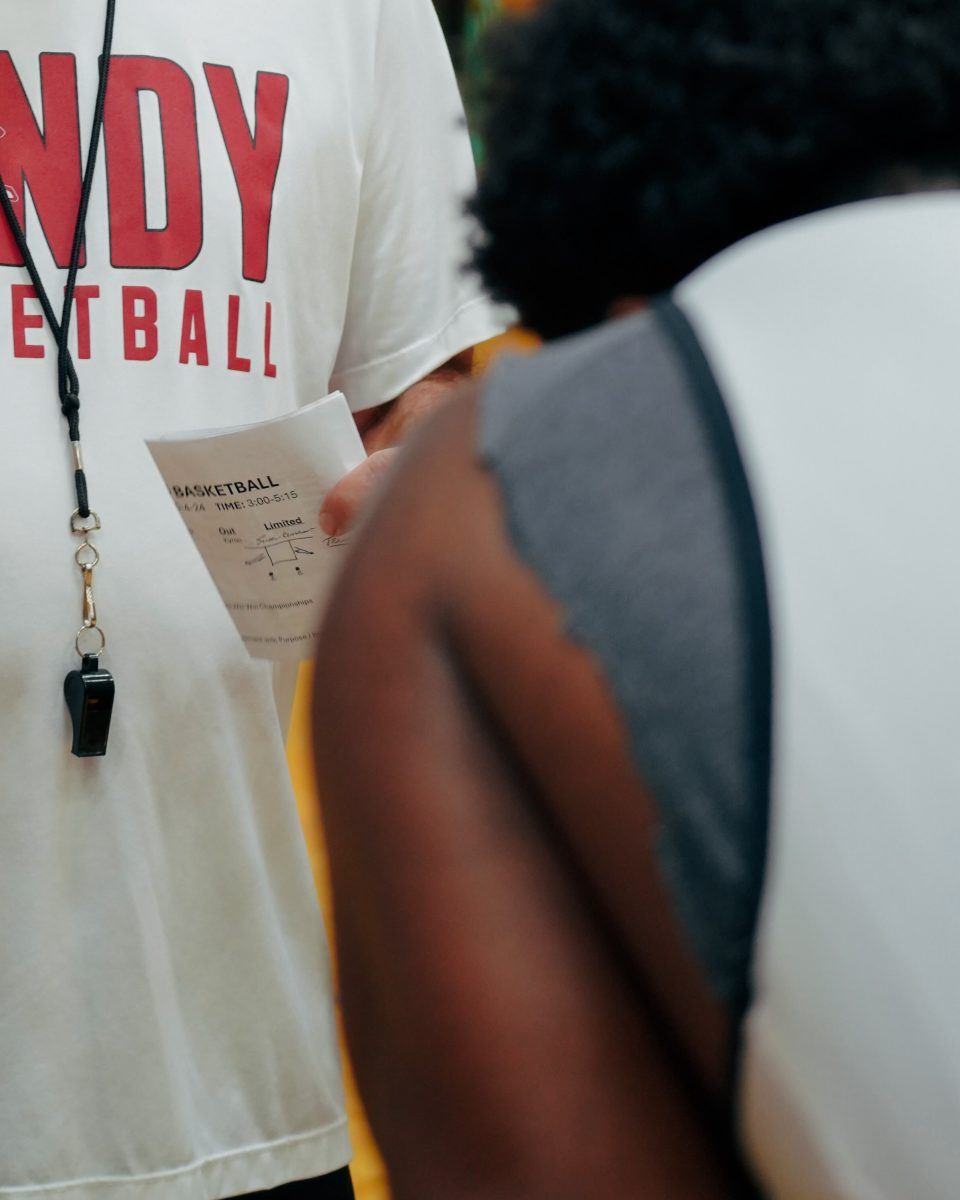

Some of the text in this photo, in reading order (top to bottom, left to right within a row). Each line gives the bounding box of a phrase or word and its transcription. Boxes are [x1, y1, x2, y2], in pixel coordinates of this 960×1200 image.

[172, 475, 280, 498] BASKETBALL
[215, 501, 246, 512] TIME:
[246, 490, 298, 508] 3:00-5:15
[264, 516, 303, 531] Limited
